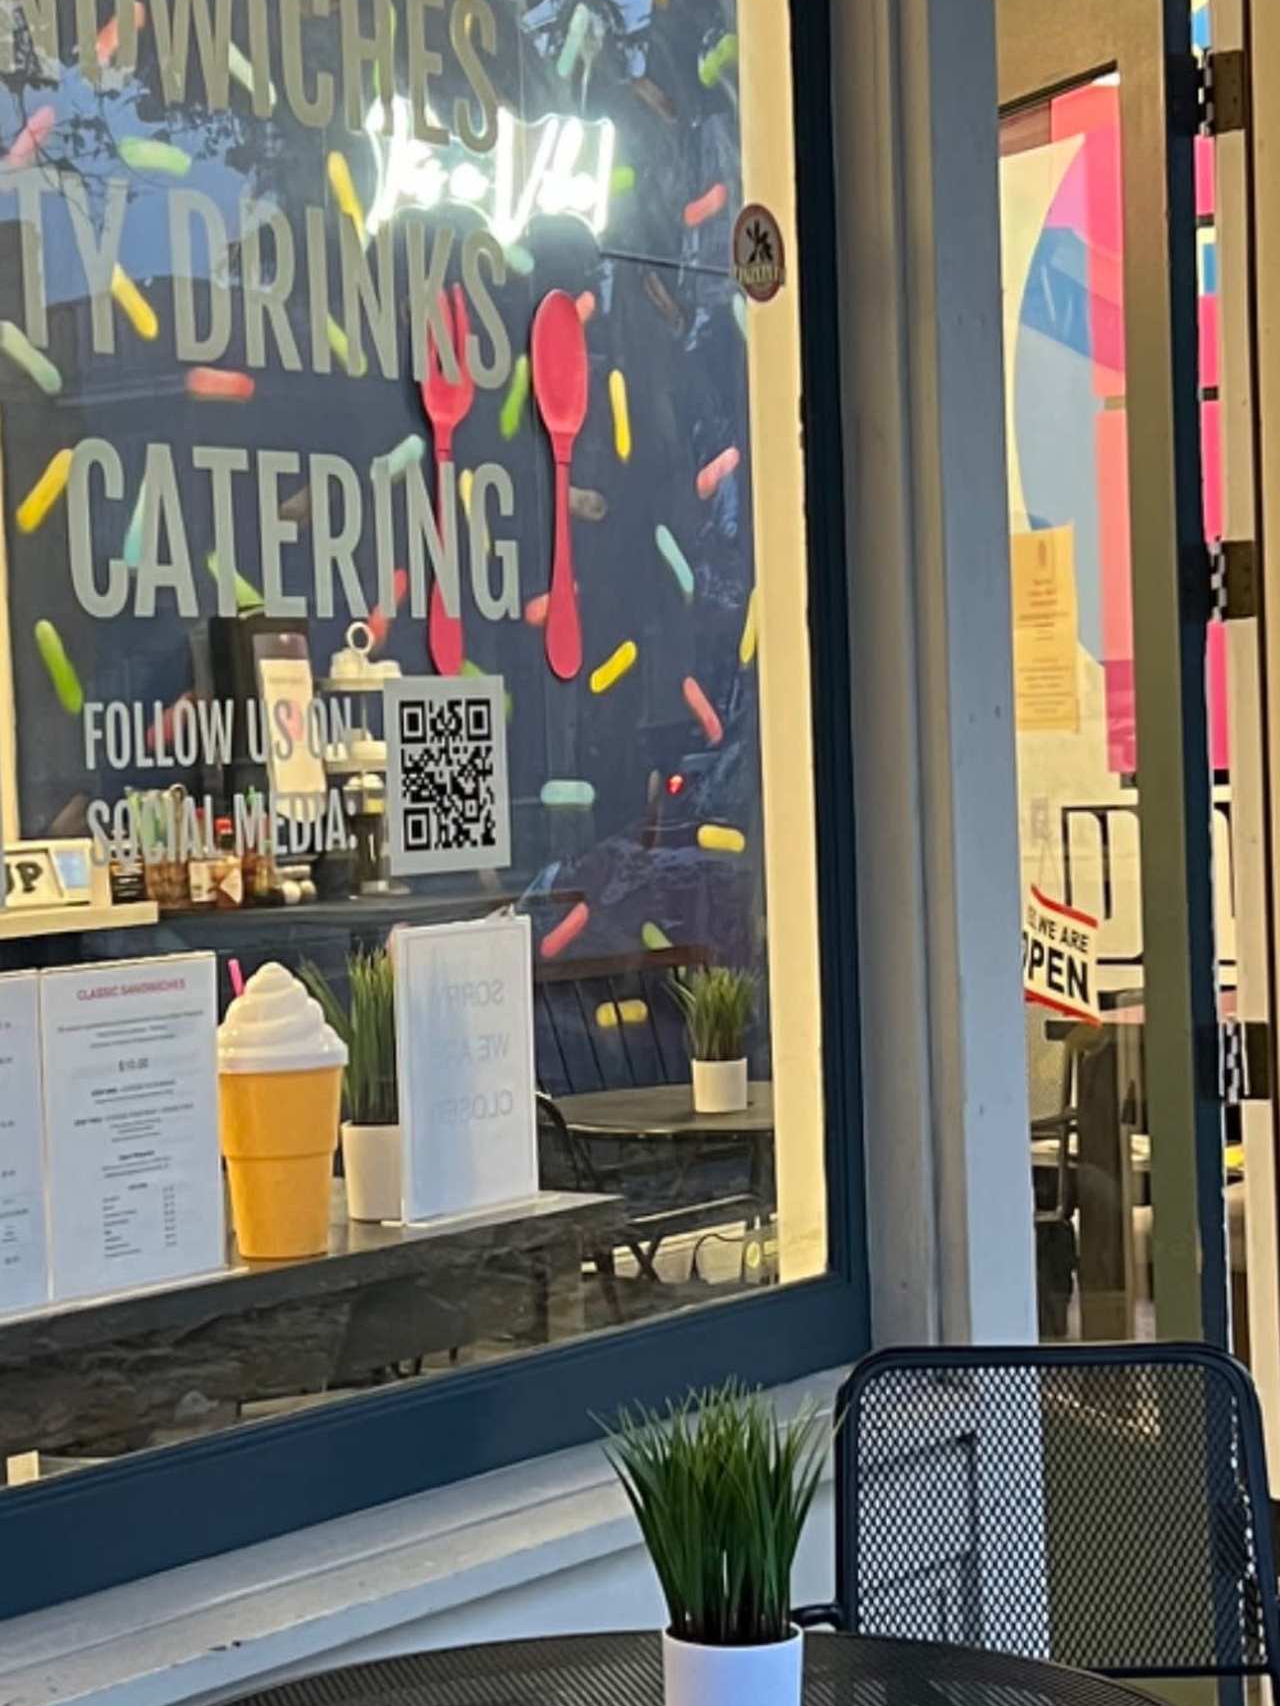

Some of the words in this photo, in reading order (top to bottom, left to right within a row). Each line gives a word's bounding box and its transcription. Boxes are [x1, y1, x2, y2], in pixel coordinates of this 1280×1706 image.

[169, 187, 512, 392] DRINKS
[66, 438, 520, 622] CATERING
[83, 698, 234, 771] FOLLOW
[247, 698, 295, 764] US
[306, 695, 355, 760] ON
[86, 795, 217, 867] SOCIAL
[1060, 924, 1091, 955] ARE
